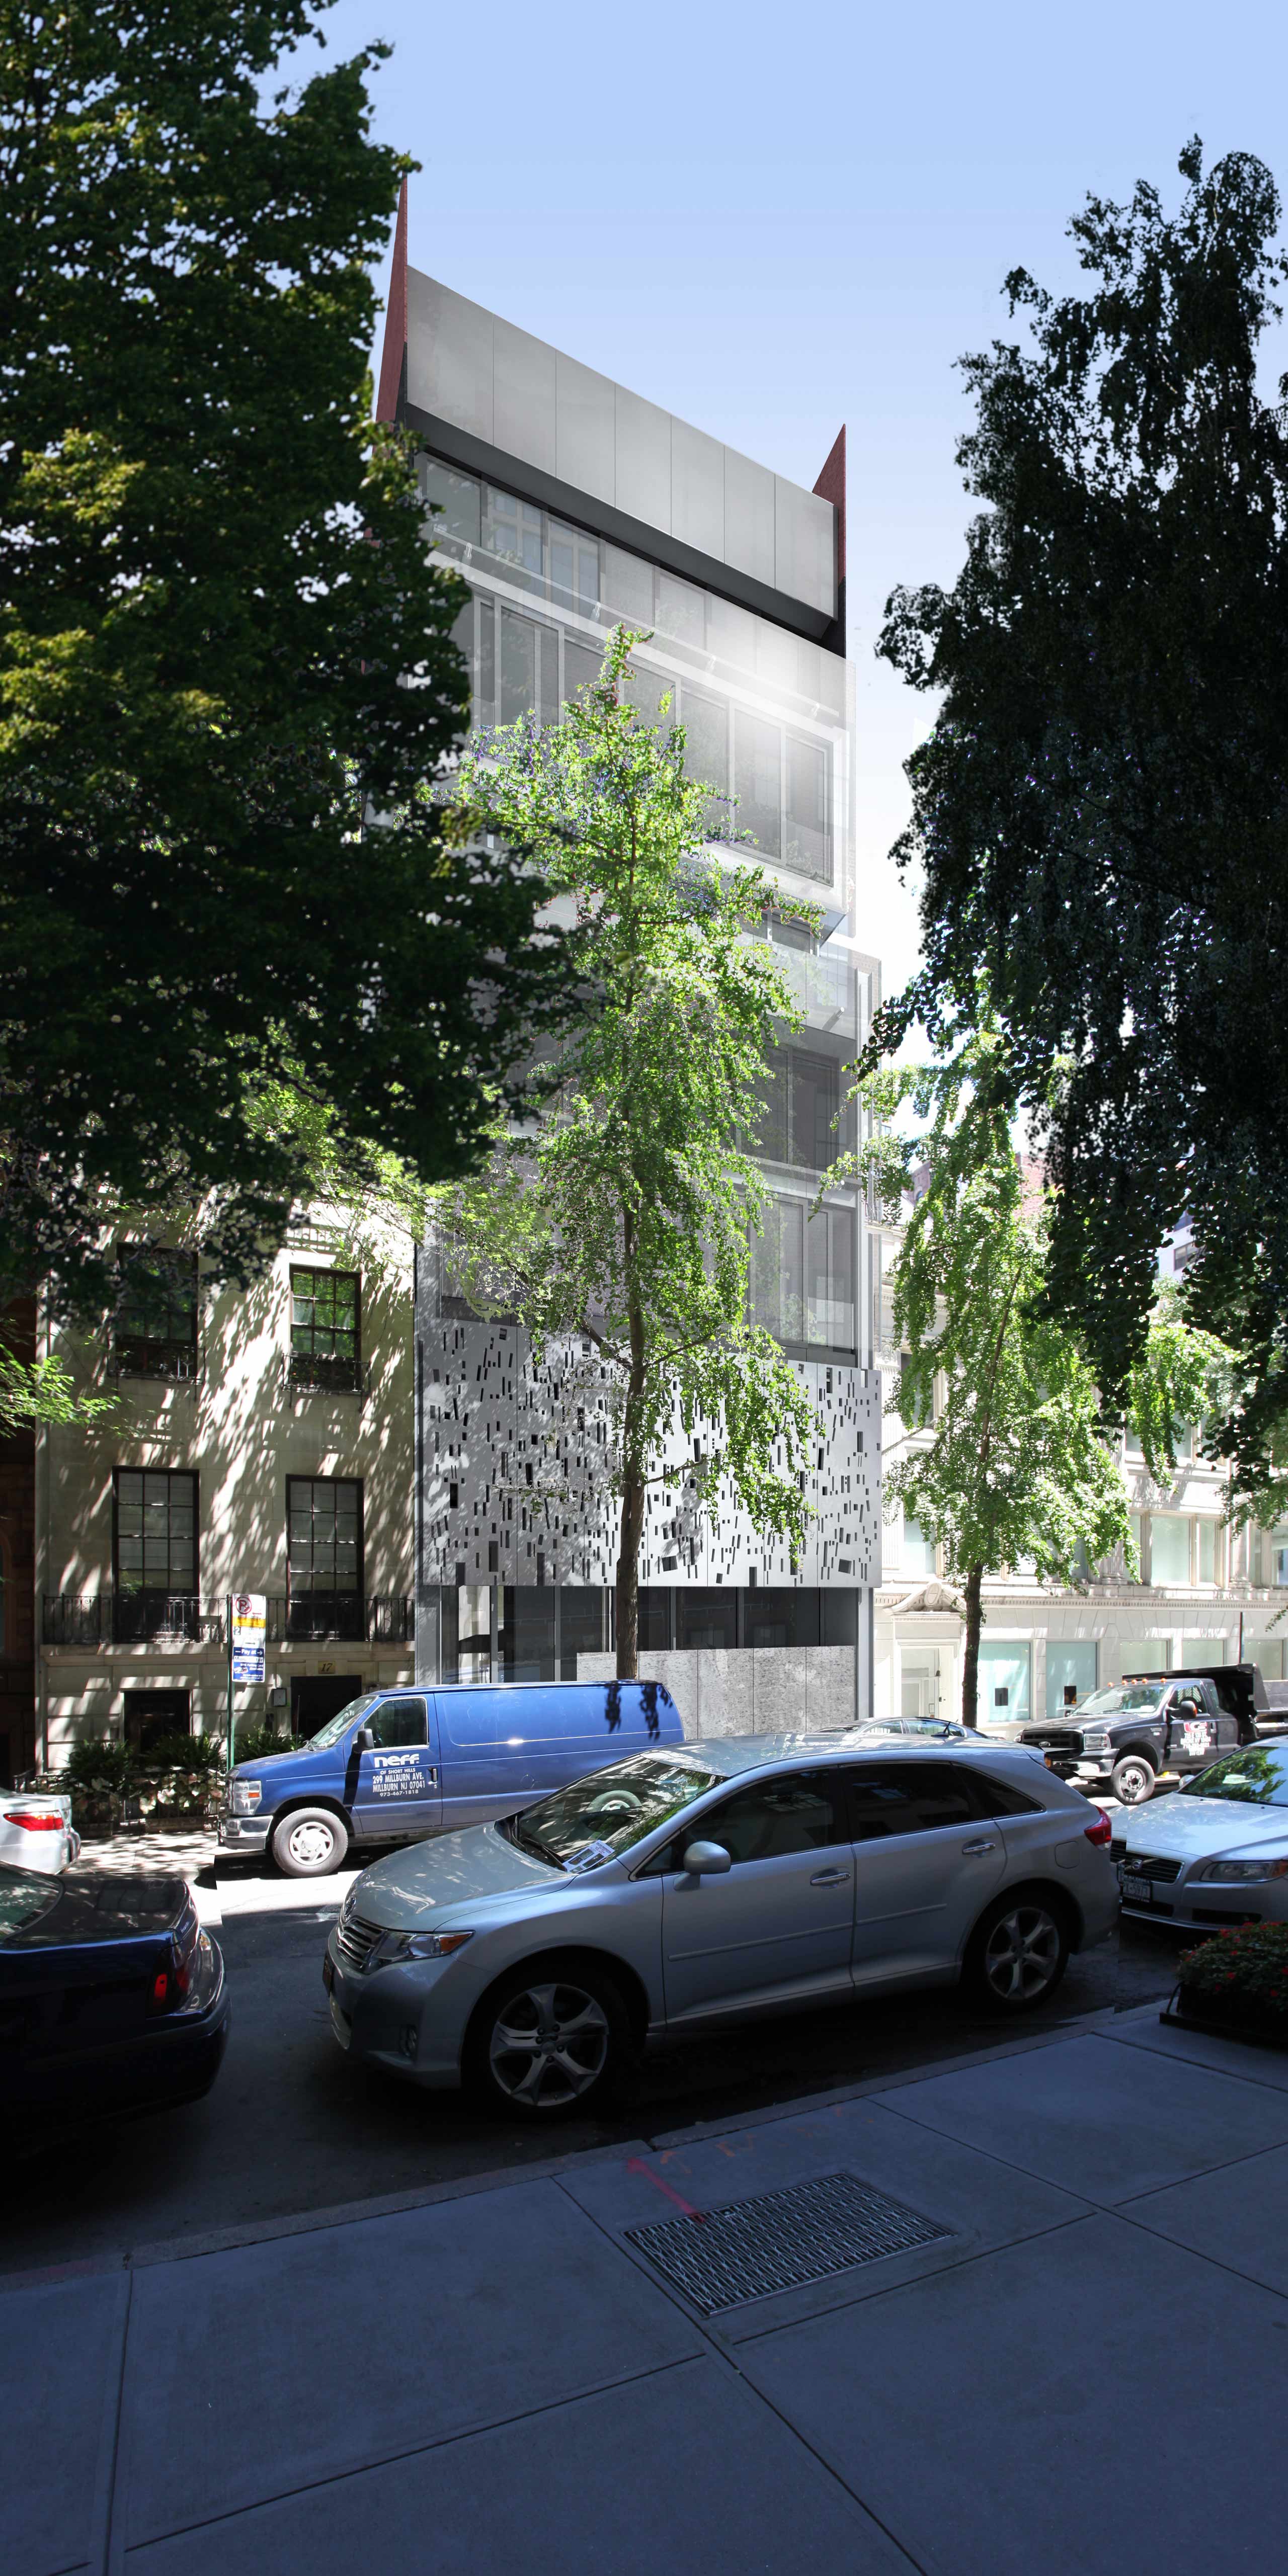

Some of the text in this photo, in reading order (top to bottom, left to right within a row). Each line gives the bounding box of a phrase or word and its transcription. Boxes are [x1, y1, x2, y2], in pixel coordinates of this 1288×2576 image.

[321, 1663, 333, 1672] 17
[374, 1754, 419, 1768] neff
[372, 1772, 424, 1784] 299 MILLBURN AVE.
[372, 1780, 425, 1793] MILLBURN NJ 07041
[379, 1789, 419, 1797] 973-467-1818
